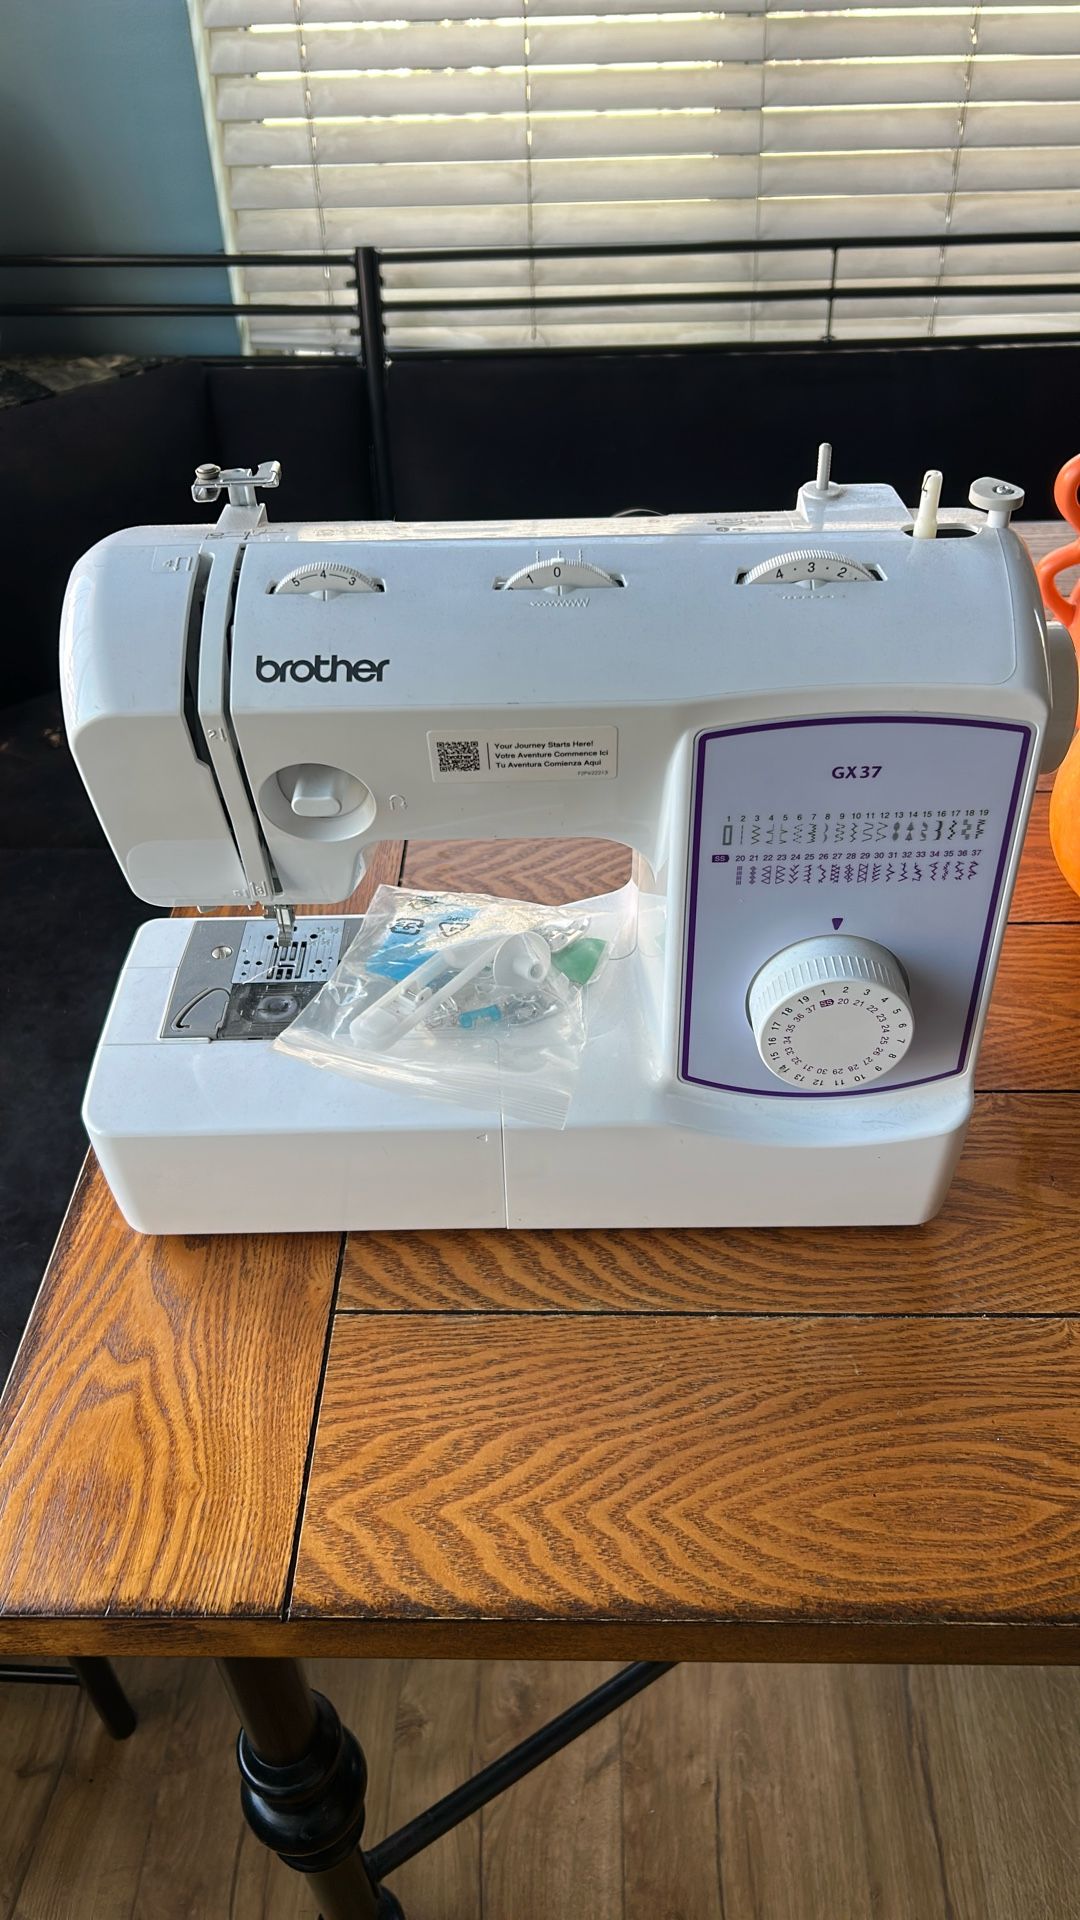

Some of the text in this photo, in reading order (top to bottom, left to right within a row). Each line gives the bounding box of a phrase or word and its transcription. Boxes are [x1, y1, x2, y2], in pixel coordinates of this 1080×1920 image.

[526, 566, 562, 584] 1 0
[775, 561, 848, 579] 4 3 2
[291, 569, 357, 587] 5 4 3
[256, 655, 390, 682] brother
[831, 765, 883, 780] GX37
[727, 815, 731, 823] 1
[740, 815, 746, 823] 2
[754, 814, 760, 822] 3
[782, 814, 788, 822] 5
[811, 813, 817, 821] 7
[824, 813, 831, 821] 8
[839, 812, 845, 820] 9
[851, 812, 862, 820] 10
[880, 811, 890, 819] 12
[894, 811, 904, 819] 13
[922, 810, 933, 818] 15
[937, 810, 947, 818] 16
[951, 809, 961, 817] 17
[965, 809, 976, 817] 18
[715, 855, 727, 863] SS
[735, 854, 746, 863] 20
[748, 854, 759, 862] 21
[762, 854, 774, 862] 22
[790, 853, 801, 861] 24
[804, 853, 815, 861] 25
[818, 853, 829, 861] 26
[832, 852, 843, 860] 27
[845, 852, 857, 860] 28
[859, 852, 871, 860] 29
[873, 851, 885, 860] 30
[887, 851, 898, 859] 31
[901, 851, 913, 859] 32
[915, 850, 927, 858] 33
[929, 850, 940, 858] 34
[943, 850, 955, 858] 35
[957, 849, 968, 857] 36
[971, 849, 983, 857] 37
[842, 986, 849, 994] 2
[863, 988, 871, 996] 3
[797, 995, 810, 1005] 19
[820, 999, 834, 1007] SS
[837, 997, 850, 1005] 20
[852, 999, 865, 1007] 21
[781, 1007, 793, 1016] 18
[805, 1004, 816, 1014] 37
[867, 1004, 879, 1014] 22
[793, 1013, 805, 1023] 36
[875, 1013, 887, 1023] 23
[771, 1021, 781, 1031] 17
[785, 1024, 796, 1033] 35
[881, 1024, 890, 1033] 24
[767, 1037, 777, 1046] 16
[783, 1035, 792, 1045] 34
[879, 1036, 890, 1045] 25
[769, 1051, 780, 1061] 15
[784, 1046, 795, 1056] 33
[872, 1047, 884, 1056] 26
[791, 1056, 803, 1066] 32
[862, 1056, 874, 1066] 27
[778, 1064, 790, 1073] 14
[802, 1064, 814, 1072] 31
[847, 1063, 860, 1072] 28
[793, 1073, 805, 1082] 13
[854, 1074, 866, 1082] 10
